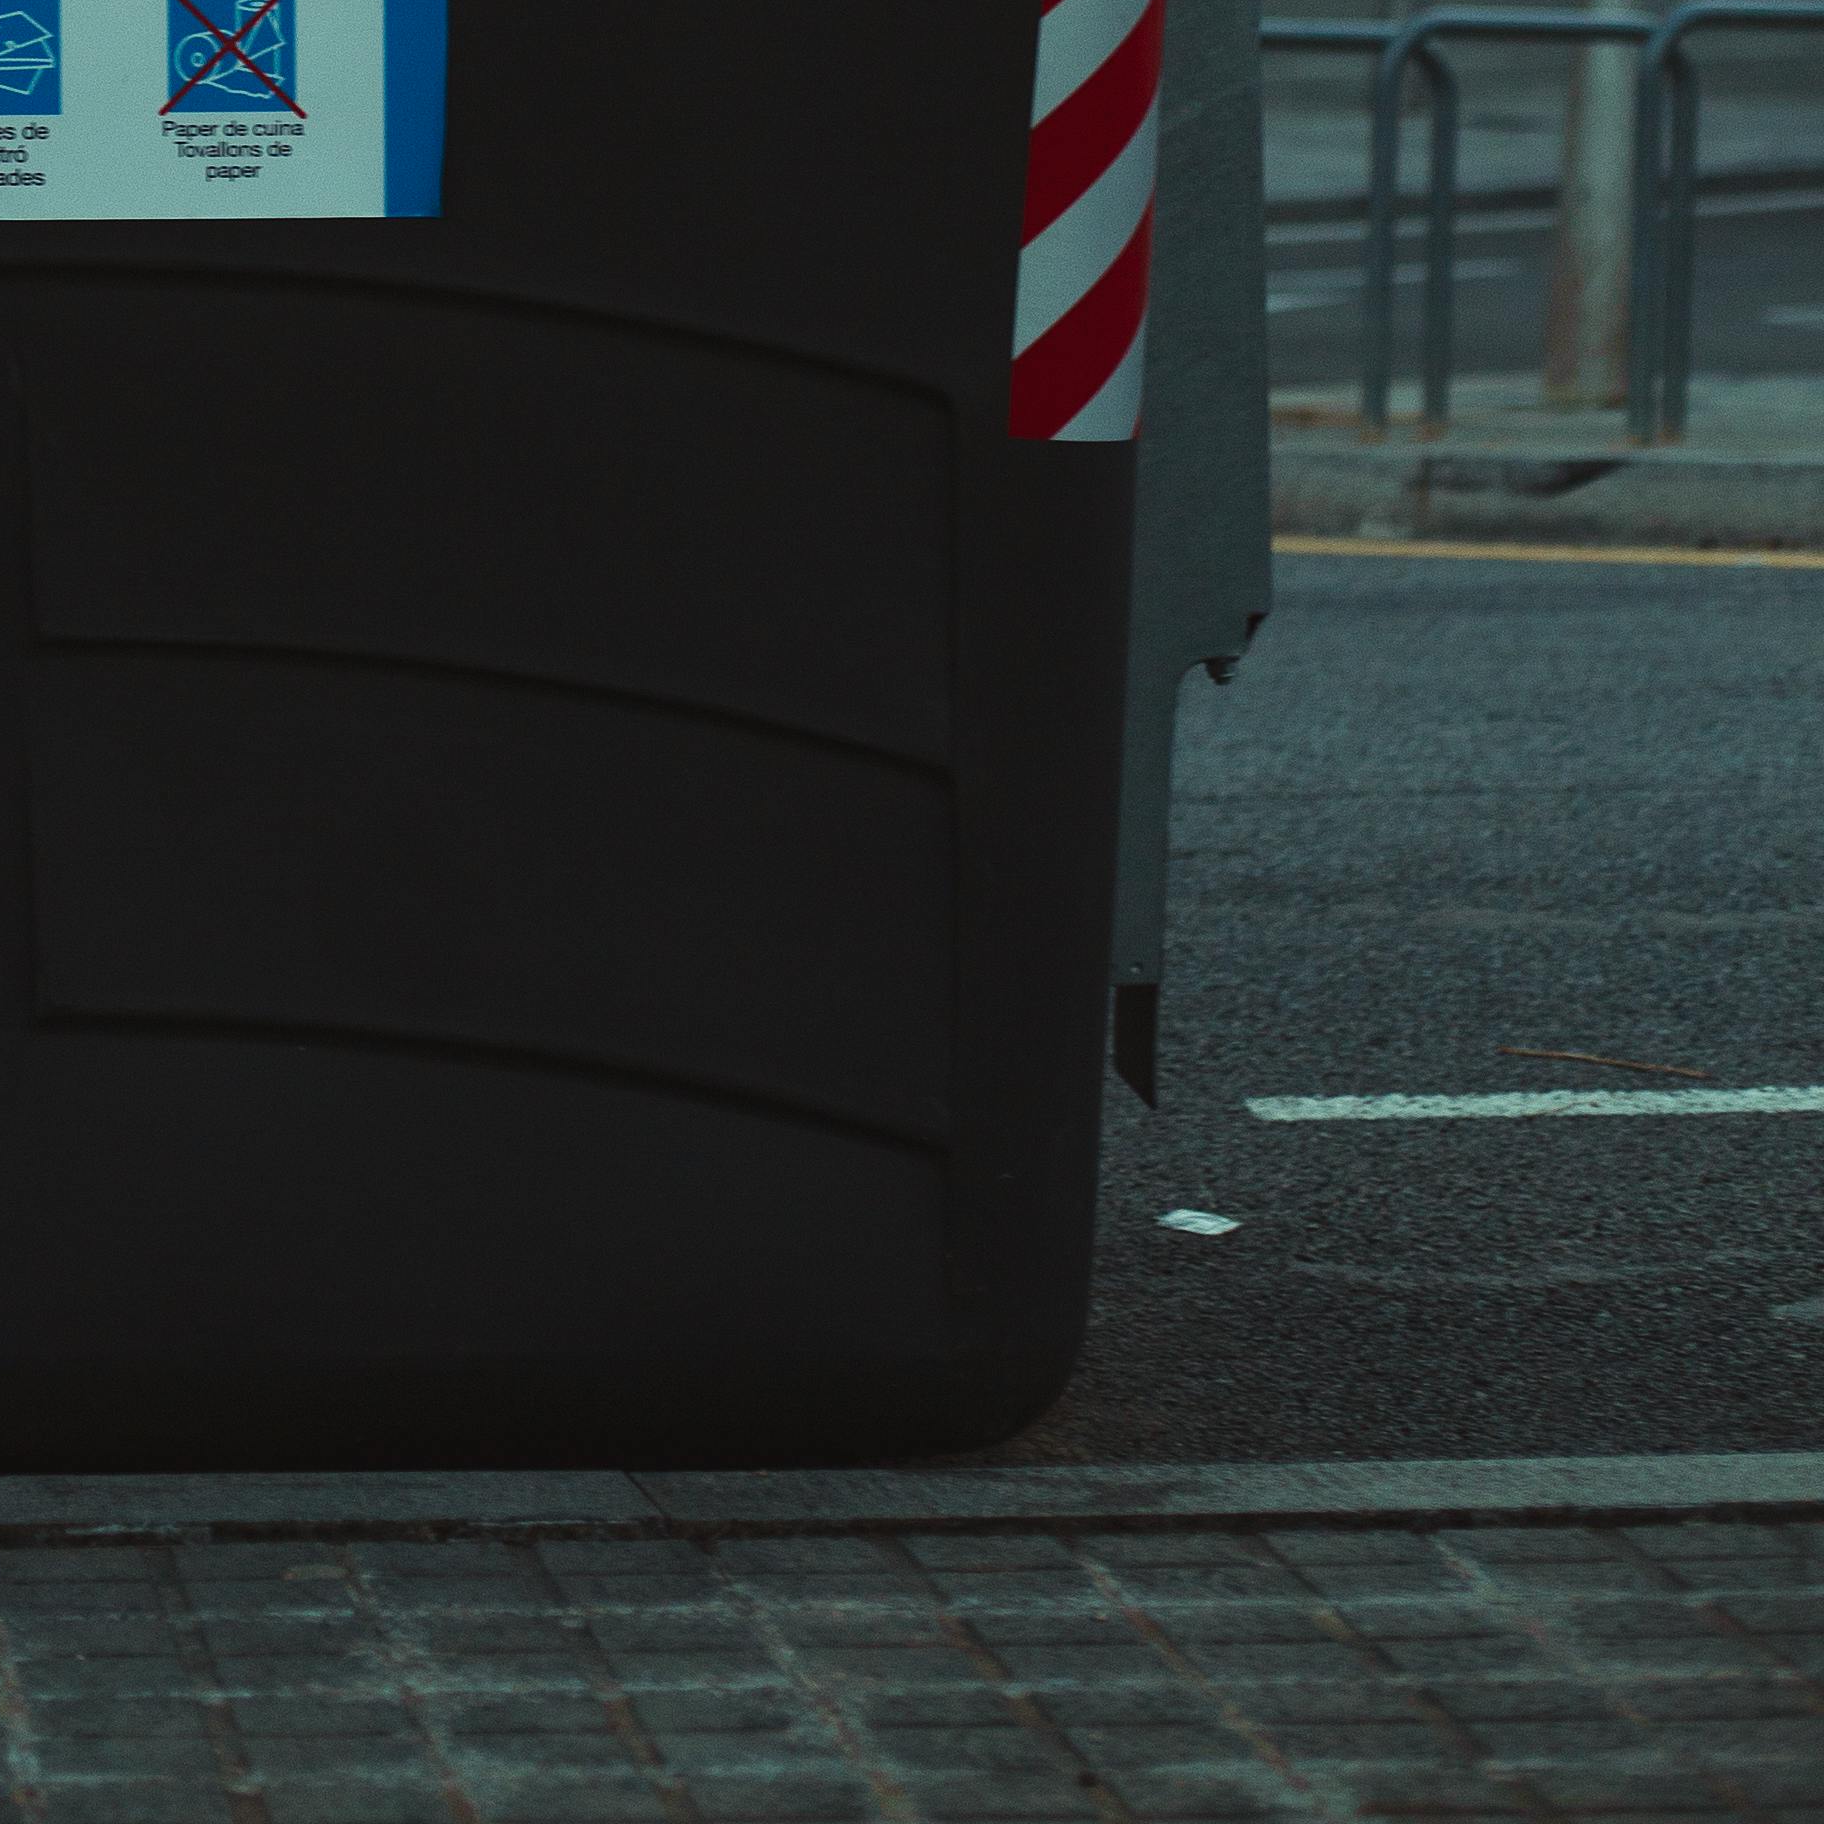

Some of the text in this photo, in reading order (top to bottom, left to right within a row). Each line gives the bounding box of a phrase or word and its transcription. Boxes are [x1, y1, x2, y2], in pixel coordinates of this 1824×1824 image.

[21, 122, 50, 141] de
[162, 120, 305, 140] Paper de cuina
[173, 141, 293, 158] Tovallons de
[206, 165, 263, 182] paper
